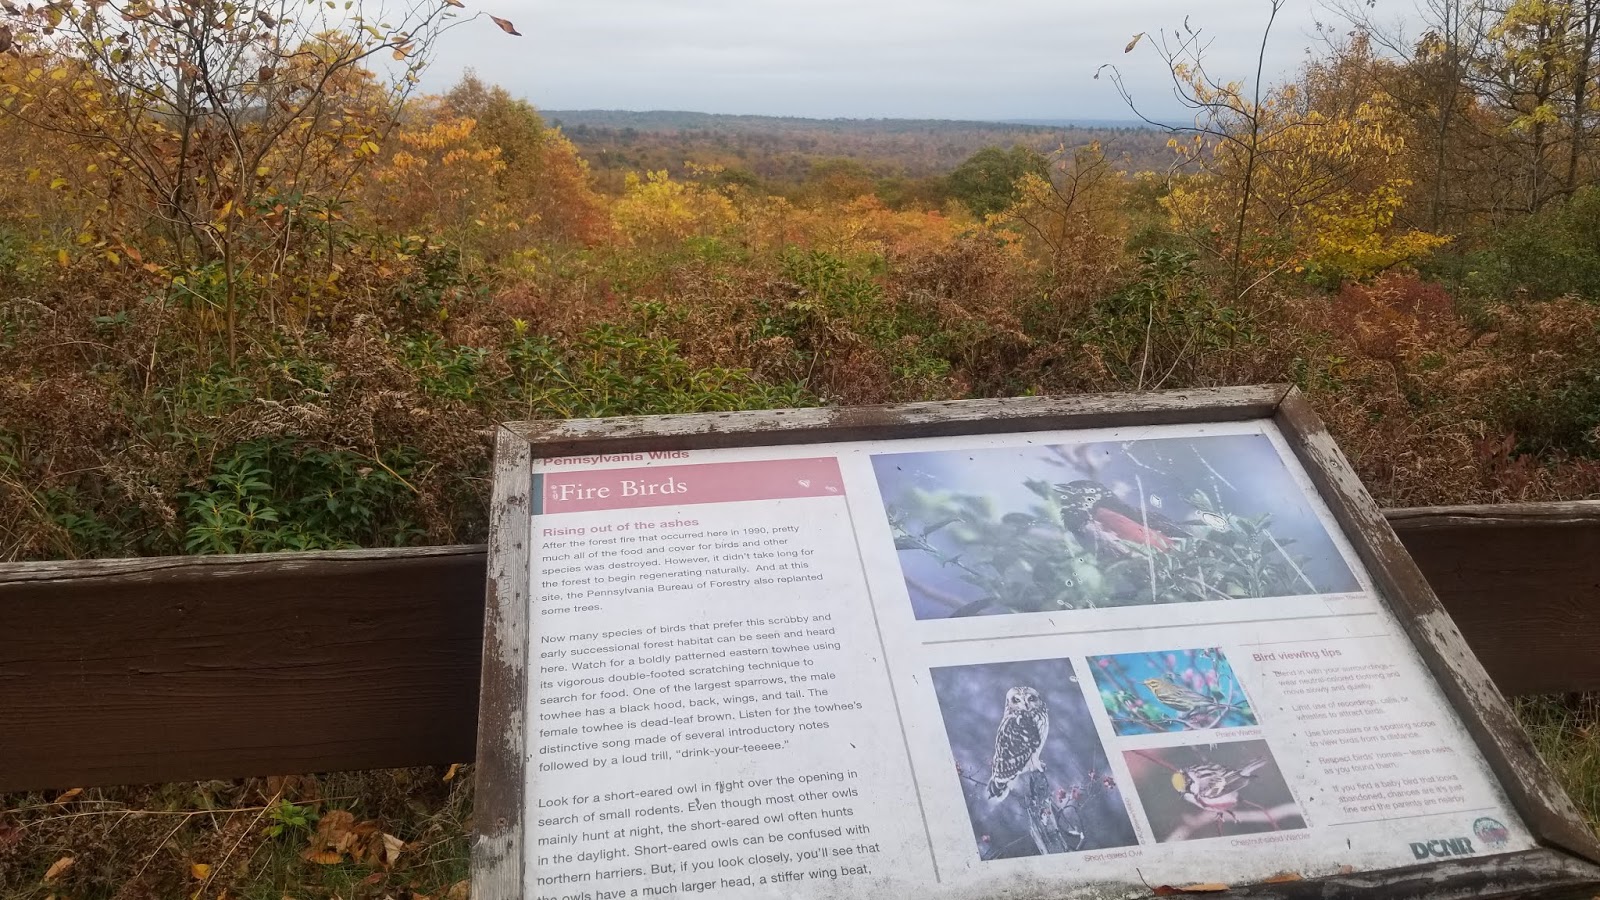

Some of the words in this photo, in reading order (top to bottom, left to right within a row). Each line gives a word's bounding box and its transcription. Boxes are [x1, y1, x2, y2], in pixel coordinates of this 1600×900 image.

[543, 453, 644, 466] Pennsylvania
[647, 450, 690, 460] Wilds
[559, 484, 610, 501] Fire
[620, 477, 688, 497] Birds
[543, 526, 585, 537] Rising
[590, 523, 612, 534] out
[617, 521, 630, 532] of
[634, 520, 655, 530] the
[660, 517, 699, 528] ashes
[542, 564, 581, 576] species
[584, 563, 604, 572] was
[608, 558, 661, 570] destroyed.
[665, 556, 710, 566] However,
[713, 554, 719, 562] it
[723, 551, 750, 562] didn't
[753, 550, 774, 560] take
[777, 549, 798, 559] long
[801, 547, 814, 556] for
[542, 593, 563, 602] site,
[567, 591, 583, 600] the
[587, 585, 654, 598] Pennsylvania
[658, 583, 693, 593] Bureau
[697, 581, 706, 590] of
[710, 578, 750, 589] Forestry
[754, 576, 774, 586] also
[777, 572, 823, 585] replanted
[541, 634, 566, 644] Now
[570, 632, 598, 642] many
[602, 628, 642, 641] species
[646, 626, 656, 636] of
[660, 624, 686, 635] birds
[689, 622, 710, 632] that
[713, 620, 743, 633] prefer
[746, 618, 765, 628] this
[768, 614, 808, 626] scrubby
[813, 612, 831, 623] and
[541, 663, 567, 673] here.
[572, 659, 606, 671] Watch
[610, 658, 625, 668] for
[629, 658, 635, 666] a
[639, 654, 670, 666] boldly
[675, 649, 726, 665] patterned
[730, 647, 768, 658] eastern
[772, 643, 810, 655] towhee
[813, 641, 840, 652] using
[1252, 651, 1276, 663] Bird
[1278, 649, 1320, 661] viewing
[1321, 647, 1342, 658] tips
[540, 680, 553, 689] its
[557, 676, 604, 689] vigorous
[608, 668, 685, 684] double-footed
[689, 664, 744, 677] scratching
[748, 659, 800, 672] technique
[803, 658, 814, 667] to
[539, 741, 598, 755] distinctive
[602, 739, 630, 749] song
[635, 734, 666, 746] made
[670, 732, 682, 743] of
[685, 728, 724, 742] several
[729, 724, 795, 738] introductory
[799, 721, 830, 731] notes
[539, 758, 588, 772] followed
[593, 756, 607, 769] by
[611, 757, 618, 765] a
[622, 752, 647, 764] loud
[651, 750, 672, 763] trill,
[539, 796, 568, 808] Look
[572, 794, 589, 805] for
[593, 794, 600, 803] a
[604, 785, 673, 802] short-eared
[677, 783, 697, 795] owl
[702, 782, 711, 793] in
[715, 779, 744, 793] flight
[748, 778, 773, 788] over
[776, 775, 794, 786] the
[798, 770, 844, 786] opening
[847, 769, 858, 779] in
[538, 812, 578, 826] search
[583, 811, 595, 822] of
[599, 807, 630, 821] small
[635, 804, 683, 817] rodents.
[688, 801, 716, 812] Even
[721, 795, 762, 810] though
[766, 793, 794, 805] most
[798, 790, 828, 802] other
[832, 787, 858, 799] owls
[538, 832, 578, 846] mainly
[583, 829, 609, 842] hunt
[614, 828, 625, 839] at
[630, 824, 663, 839] night,
[667, 822, 686, 834] the
[691, 814, 760, 832] short-eared
[764, 812, 784, 825] owl
[788, 810, 818, 822] often
[821, 807, 854, 819] hunts
[538, 854, 548, 866] in
[553, 852, 572, 864] the
[577, 846, 629, 863] daylight.
[635, 838, 706, 856] Short-eared
[711, 836, 739, 849] owls
[743, 835, 764, 846] can
[768, 832, 784, 844] be
[788, 826, 842, 842] confused
[845, 823, 870, 837] with
[1409, 837, 1475, 860] DCNR
[537, 871, 590, 885] northern
[596, 866, 646, 880] harriers.
[651, 862, 676, 875] But,
[681, 859, 688, 872] if
[692, 859, 714, 873] you
[718, 854, 744, 868] look
[748, 850, 792, 865] closely,
[796, 846, 828, 863] you'll
[832, 846, 853, 857] see
[856, 842, 880, 855] that
[596, 888, 626, 900] have
[631, 887, 638, 897] a
[643, 881, 677, 896] much
[682, 880, 716, 894] larger
[721, 874, 754, 889] head,
[760, 875, 767, 885] a
[771, 870, 804, 884] stiffer
[809, 868, 838, 882] wing
[841, 864, 871, 878] beat,
